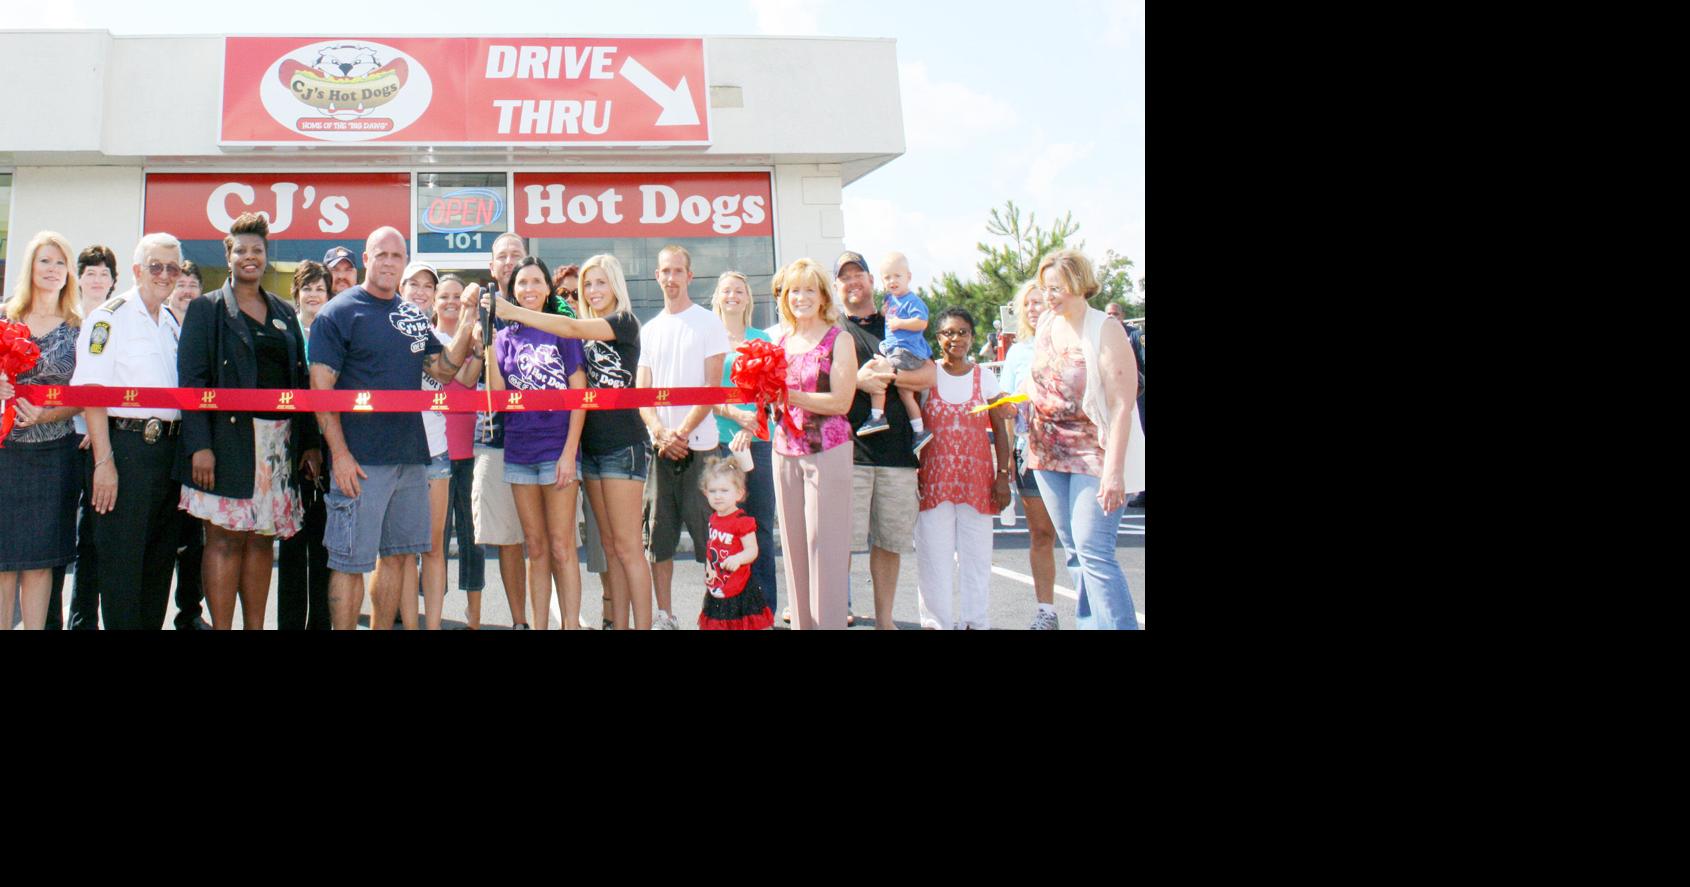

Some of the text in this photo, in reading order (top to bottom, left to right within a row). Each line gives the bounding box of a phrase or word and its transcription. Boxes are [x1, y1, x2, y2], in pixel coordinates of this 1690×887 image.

[485, 45, 618, 79] DRIVE
[292, 80, 398, 101] CJ's Hot Dogs
[492, 99, 612, 134] THRU
[206, 182, 350, 234] CJ's
[428, 196, 495, 226] OPEN
[523, 183, 766, 234] Hot Dogs
[444, 232, 482, 249] 101
[599, 374, 625, 389] Dogs
[709, 527, 734, 545] LOVE
